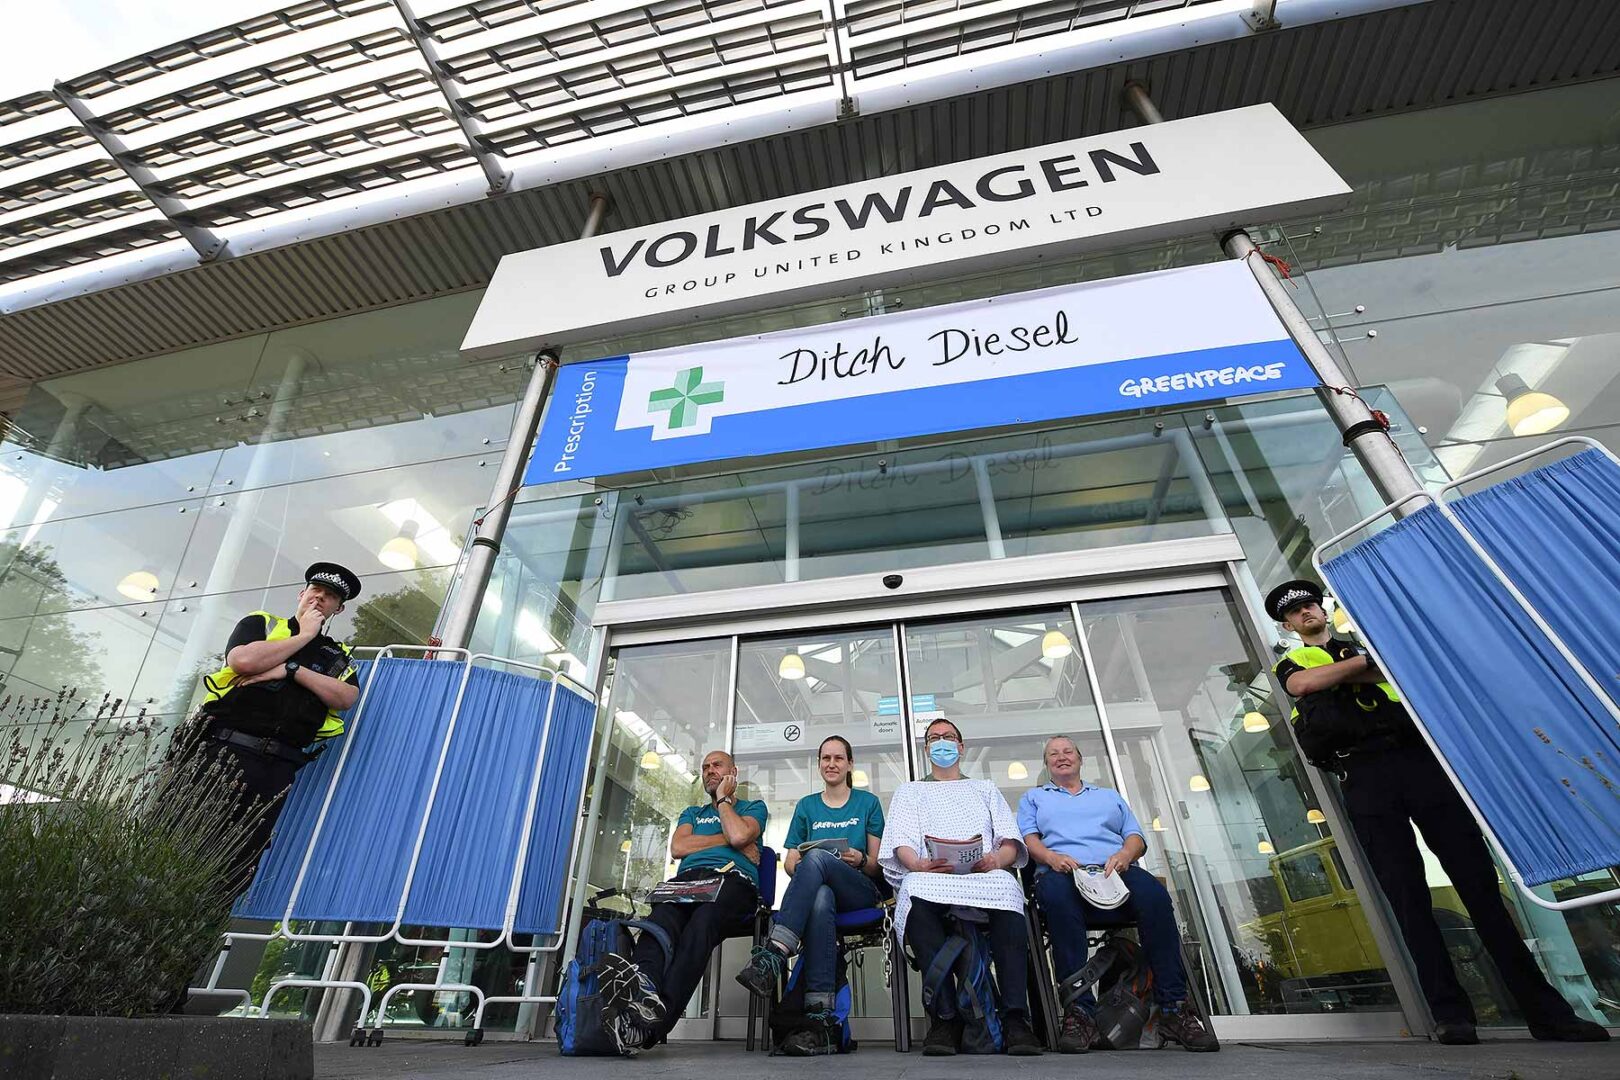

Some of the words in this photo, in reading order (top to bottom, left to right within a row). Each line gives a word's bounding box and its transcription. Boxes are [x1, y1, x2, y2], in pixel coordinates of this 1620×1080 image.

[600, 141, 1161, 278] VOLKSWAGEN
[645, 272, 736, 298] GROUP
[754, 249, 861, 278] UNITED
[881, 218, 1031, 254] KINGDOM
[1050, 206, 1103, 224] LTD
[777, 336, 906, 385] Ditch
[928, 310, 1079, 366] Diesel
[1118, 362, 1287, 398] GREENPEACE
[553, 371, 598, 473] Prescription
